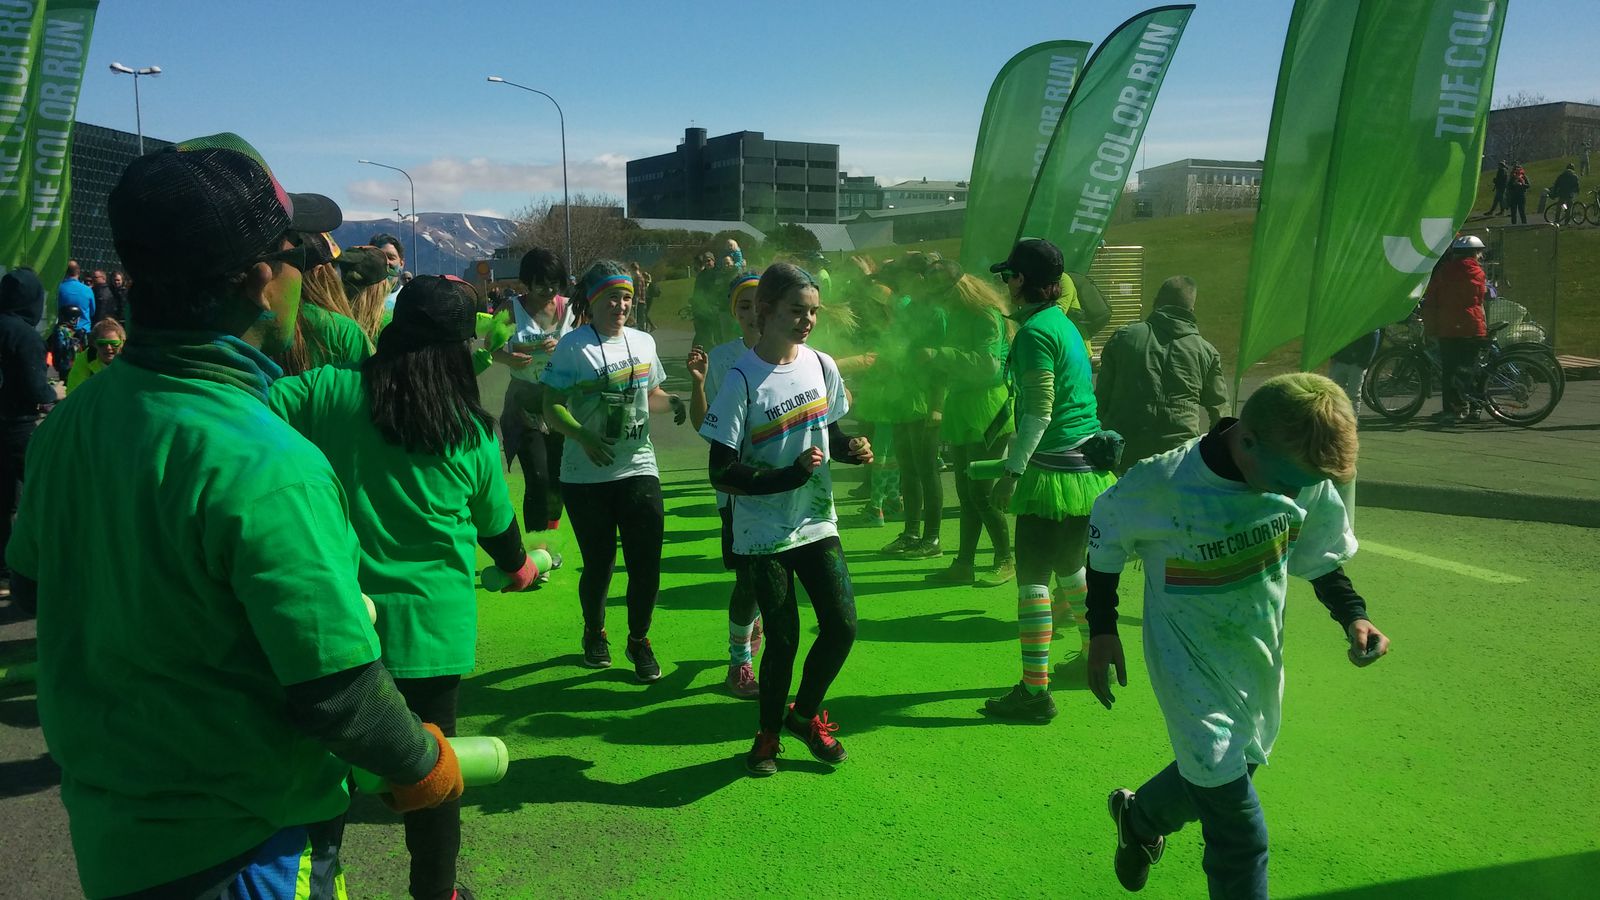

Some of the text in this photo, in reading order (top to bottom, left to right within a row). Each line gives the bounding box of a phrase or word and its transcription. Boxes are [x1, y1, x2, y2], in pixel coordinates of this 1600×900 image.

[1044, 55, 1078, 102] RUN
[31, 19, 86, 231] THE COLOR RUN
[1068, 22, 1178, 235] THE COLOR RUN
[1434, 74, 1481, 138] THE
[607, 360, 628, 373] COLOR
[764, 388, 820, 421] THE COLOR RUN
[1197, 540, 1225, 561] THE
[1227, 524, 1271, 555] COLOR
